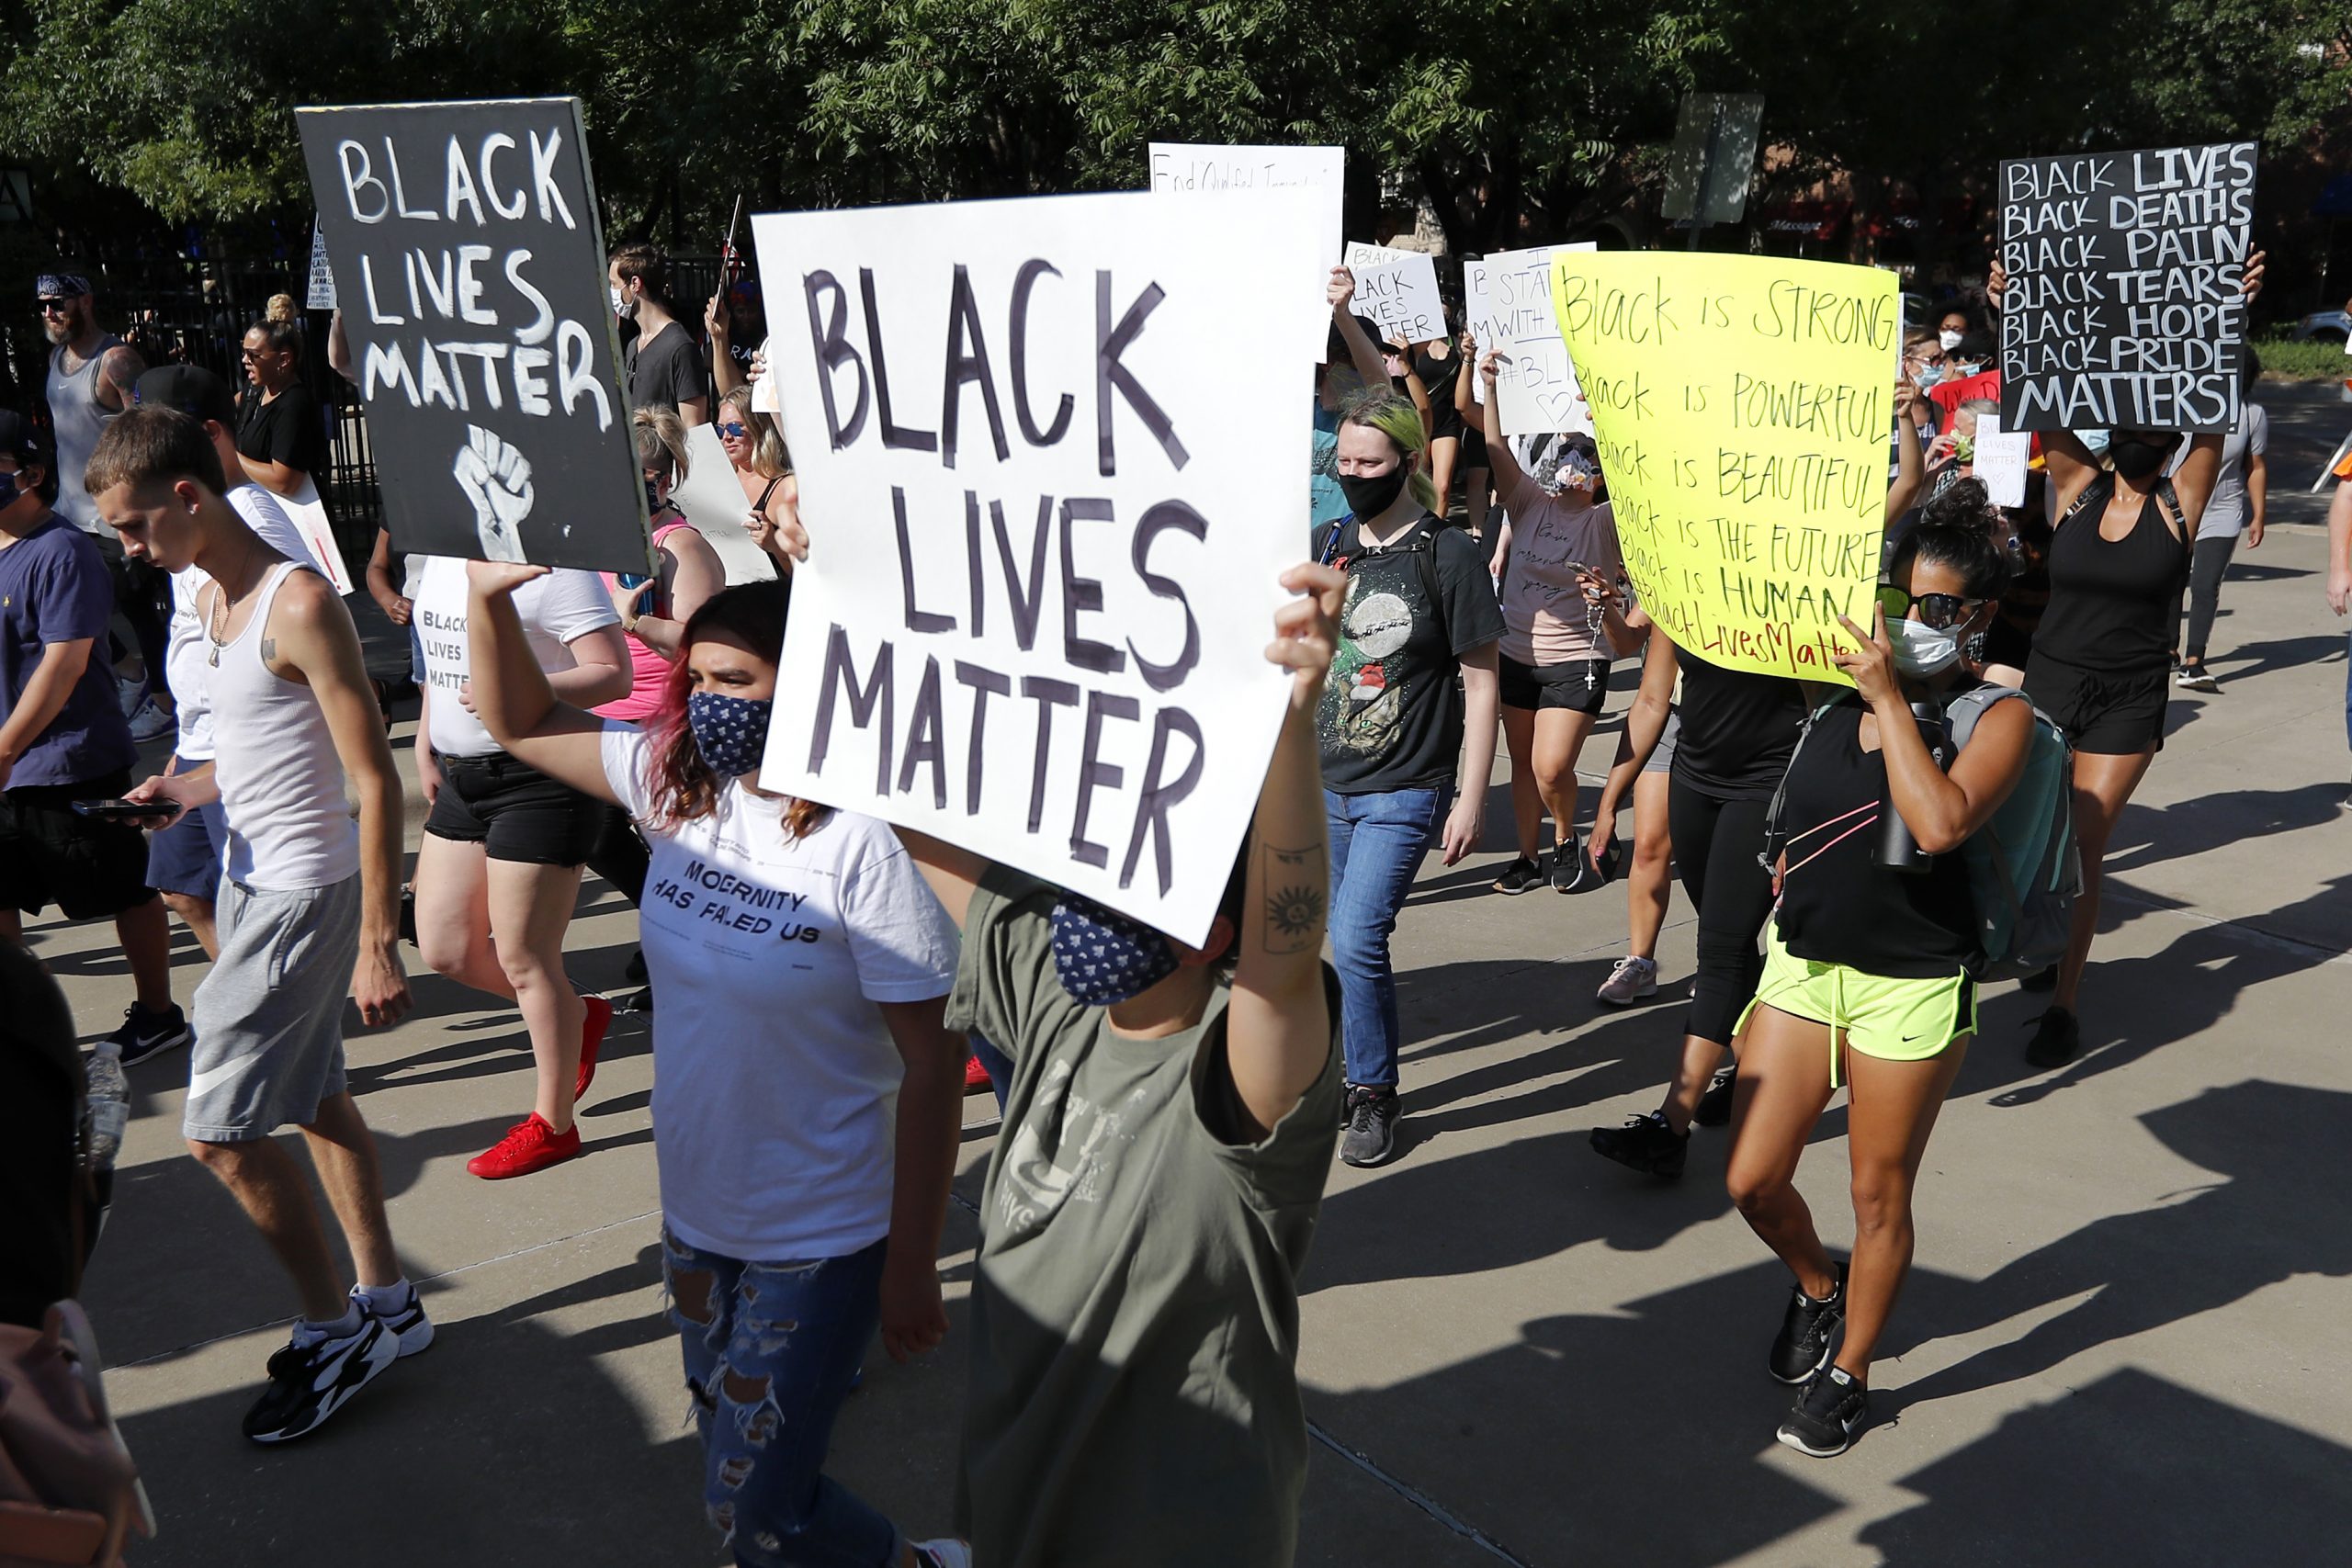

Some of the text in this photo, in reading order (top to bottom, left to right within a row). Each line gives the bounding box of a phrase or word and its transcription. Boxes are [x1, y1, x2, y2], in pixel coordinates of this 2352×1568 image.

[338, 126, 576, 230] BLACK
[2007, 142, 2255, 202] BLACK LIVES
[2004, 187, 2253, 242] BLACK DEATHS
[1527, 248, 1551, 268] I
[2004, 225, 2250, 276] BLACK PAIN
[361, 244, 554, 345] LIVES
[1353, 270, 1414, 301] LACK
[1360, 297, 1408, 320] IVES
[1562, 265, 1894, 351] Black is STRONG
[2004, 265, 2246, 314] BLACK TEARS
[1378, 314, 1433, 338] TER
[1492, 308, 1544, 337] WITH
[2002, 303, 2244, 350] BLACK HOPE
[366, 320, 612, 434] MATTER
[802, 257, 1190, 477] BLACK
[1500, 353, 1570, 388] #BL
[2003, 335, 2242, 384] BLACK PRIDE
[1574, 362, 1888, 445] Black is POWERFUL
[2012, 371, 2239, 432] MATTERS!
[1980, 455, 2018, 465] MATTER
[1983, 440, 2016, 451] LIVES
[1674, 450, 1697, 488] is
[1718, 446, 1881, 518] BEAUTIFUL
[1607, 475, 1883, 582] Black is THE FUTURE
[890, 485, 1209, 693] LIVES
[1618, 525, 1854, 626] Black is HUMAN
[424, 611, 468, 632] BLACK
[426, 639, 461, 660] LIVES
[429, 669, 469, 689] MATTE
[806, 622, 1205, 900] MATTER
[699, 902, 772, 934] FAED
[780, 921, 820, 943] US
